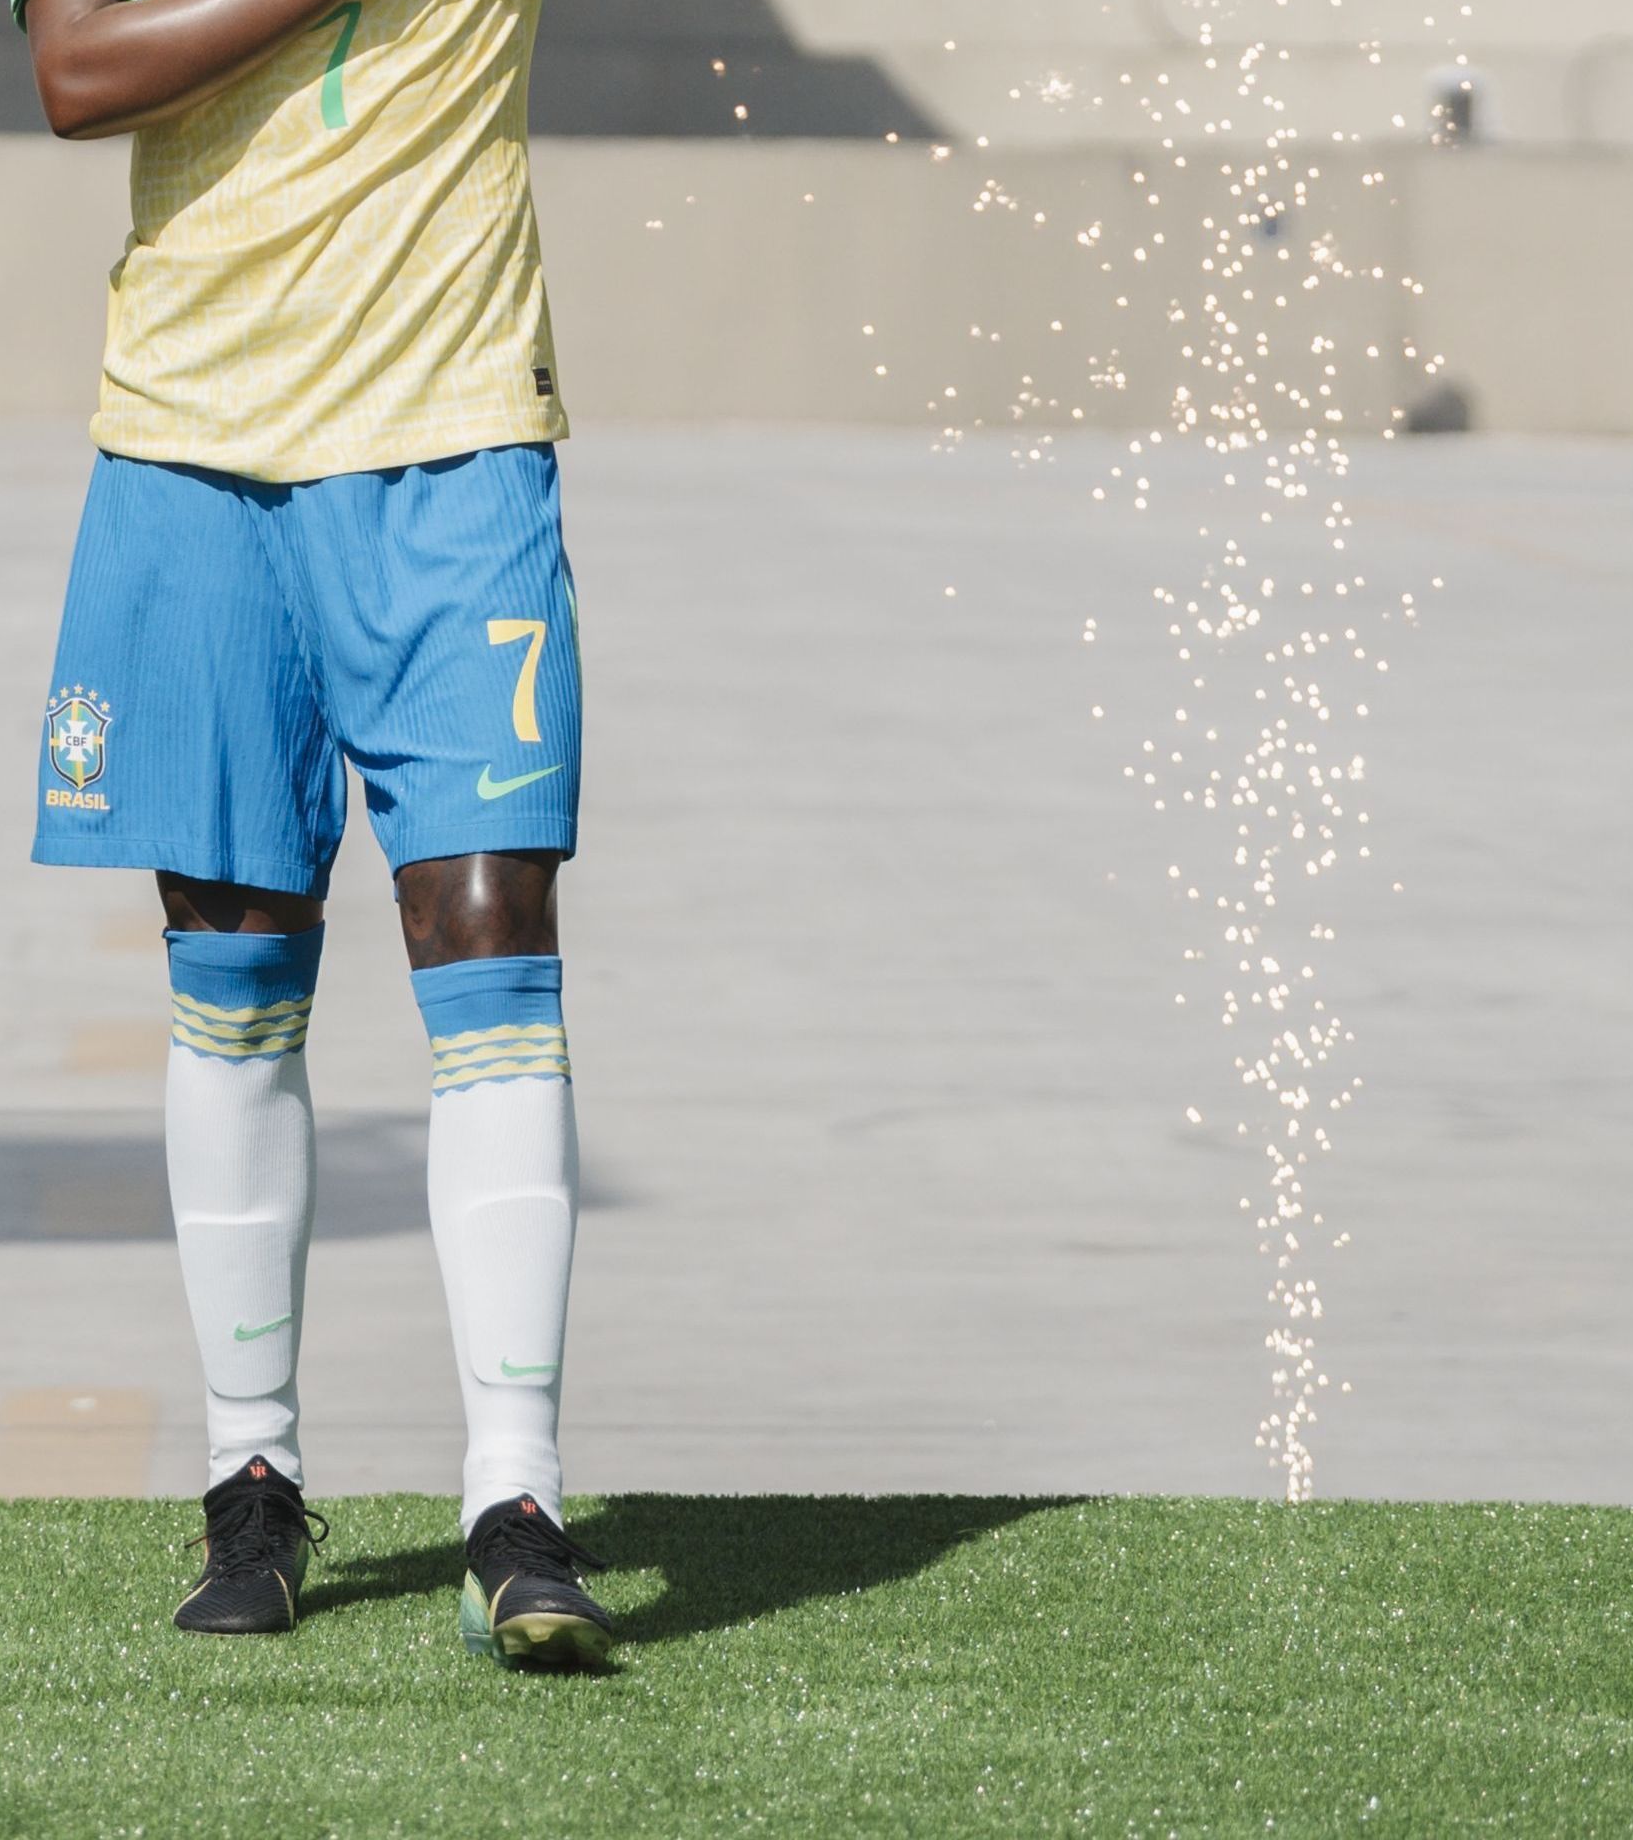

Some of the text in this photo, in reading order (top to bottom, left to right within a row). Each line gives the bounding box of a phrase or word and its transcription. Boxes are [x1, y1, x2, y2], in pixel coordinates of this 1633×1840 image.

[307, 1, 363, 130] 7
[486, 619, 546, 742] 7
[65, 735, 87, 747] CBF
[46, 789, 110, 810] BRASIL
